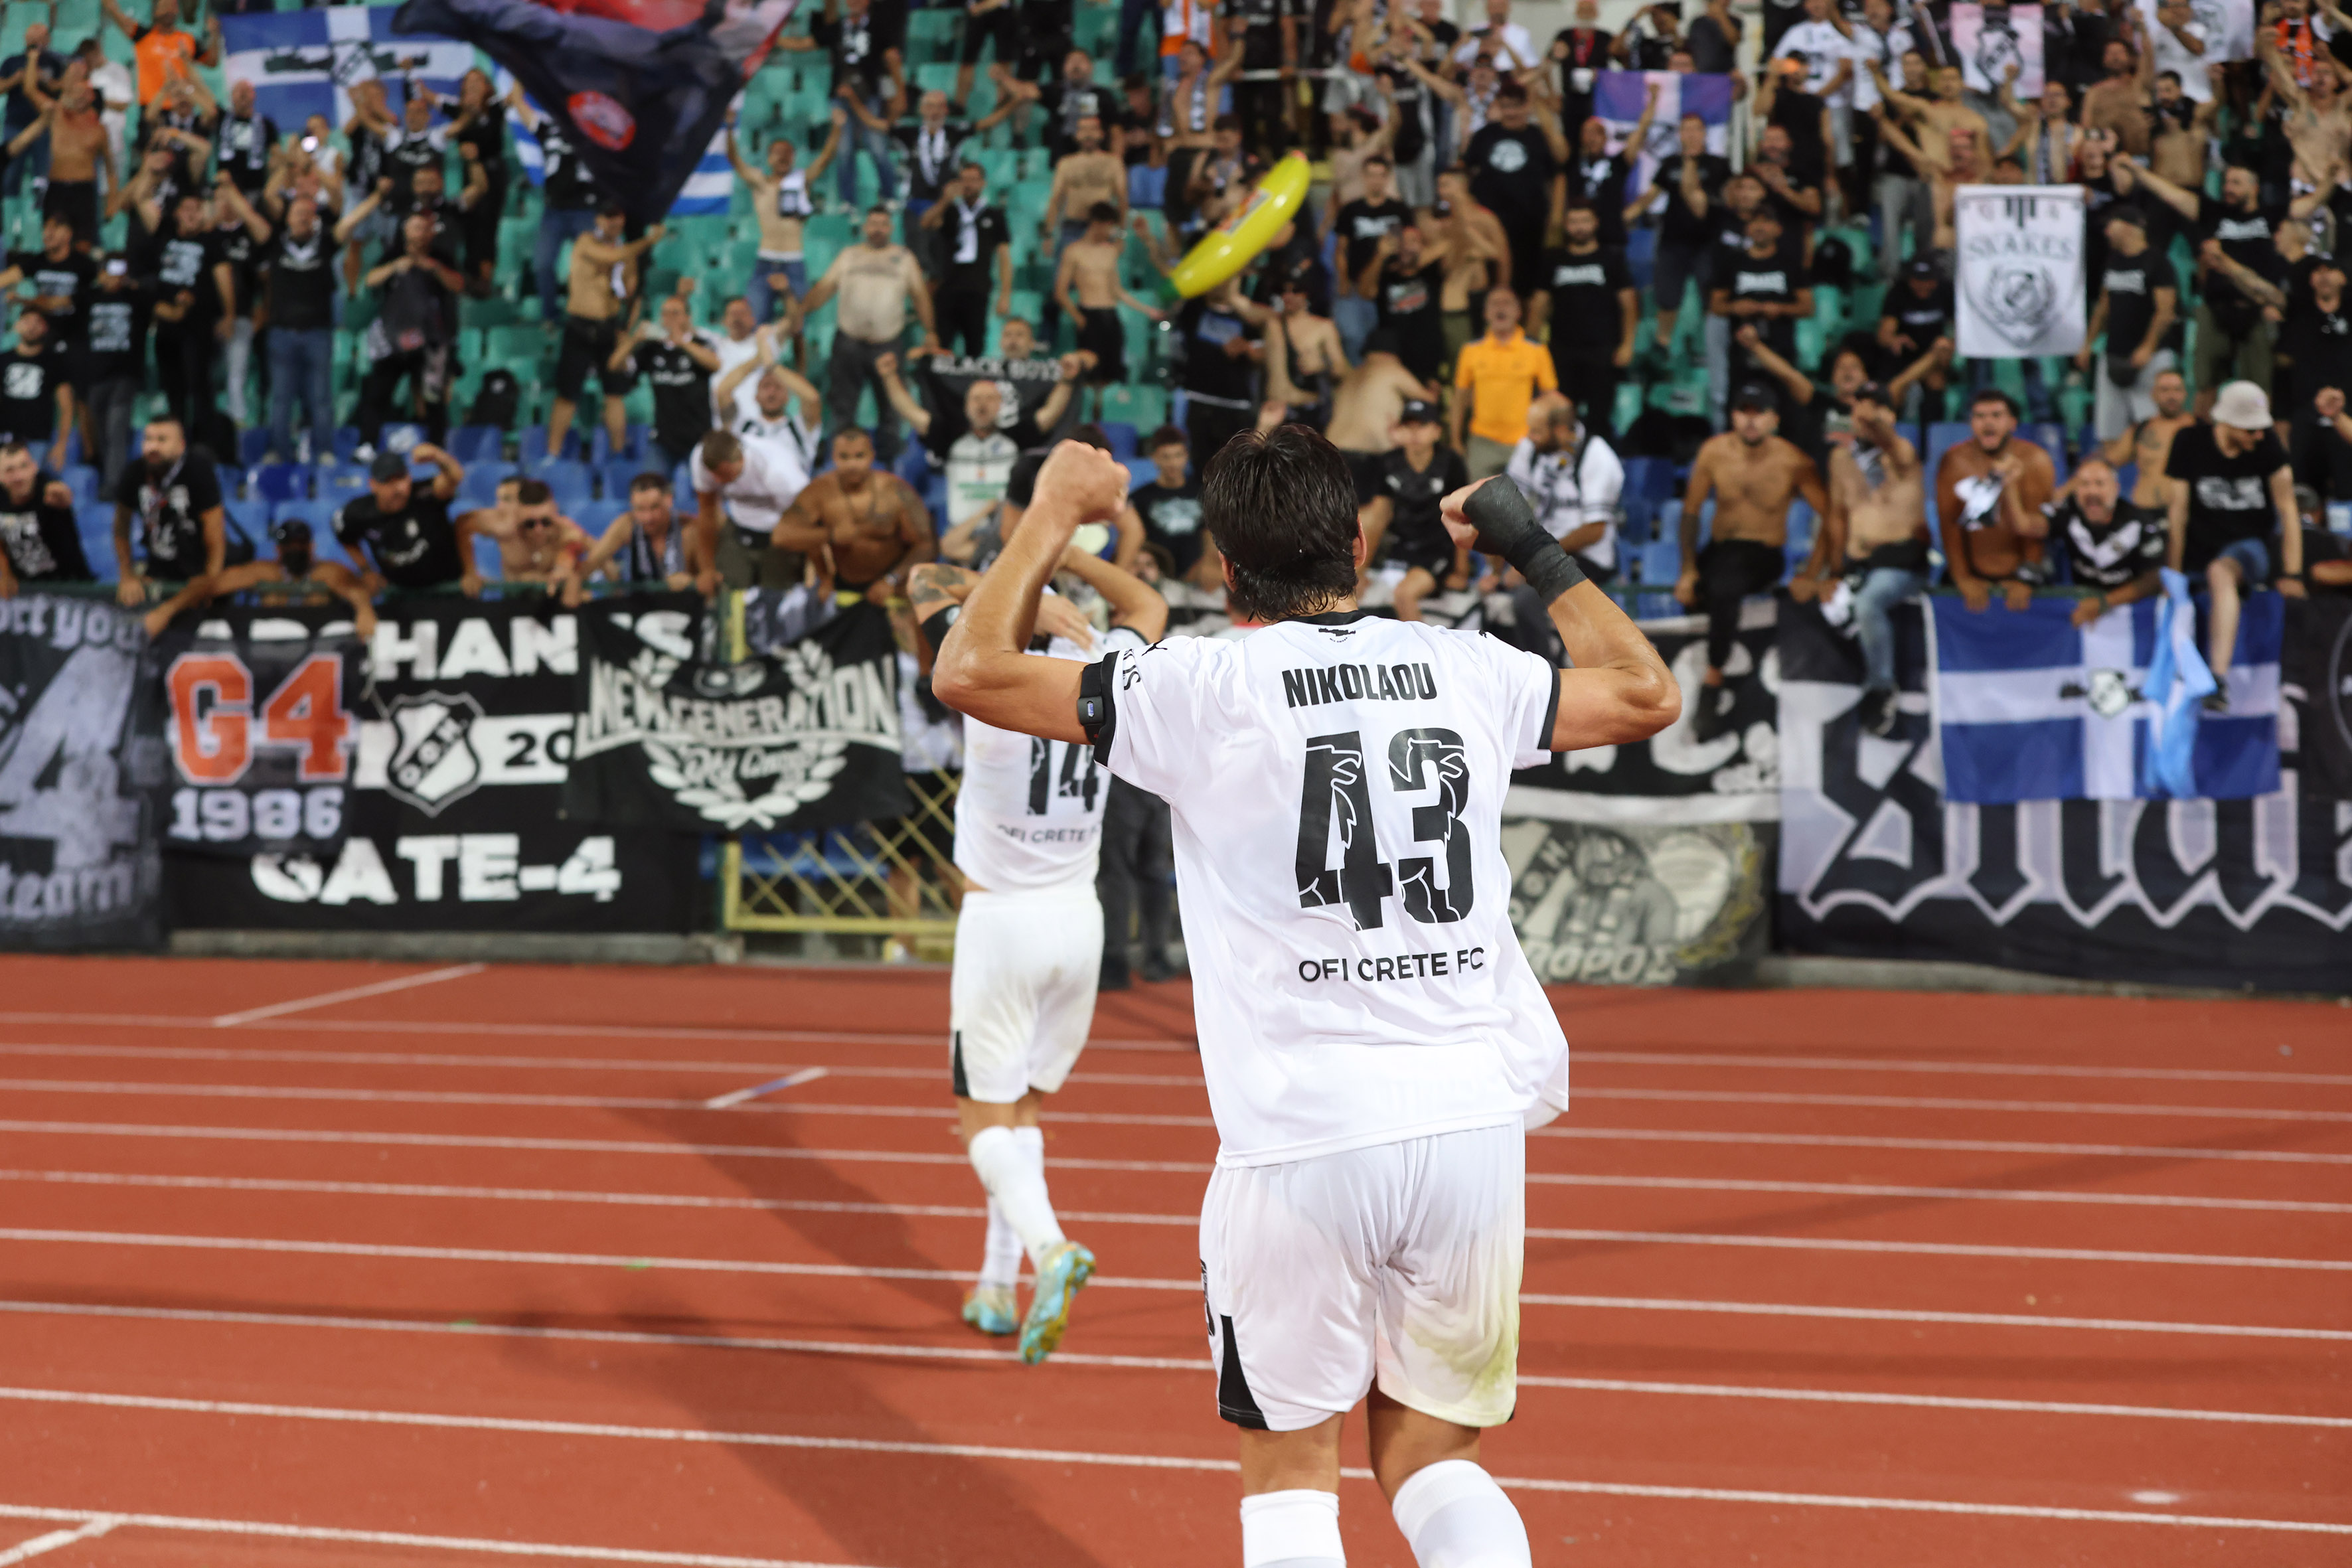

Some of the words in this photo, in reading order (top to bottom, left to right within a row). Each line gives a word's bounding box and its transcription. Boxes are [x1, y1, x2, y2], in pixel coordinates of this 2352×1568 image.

[1282, 663, 1437, 708] NIKOLAOU
[166, 651, 351, 786] G4
[1027, 736, 1099, 815] 14
[169, 788, 344, 840] 1986
[1031, 828, 1085, 844] CRETE
[1295, 728, 1474, 931] 43
[251, 834, 621, 905] GATE-4
[1298, 959, 1349, 982] OFI
[1358, 952, 1448, 981] CRETE
[1457, 947, 1484, 974] FC
